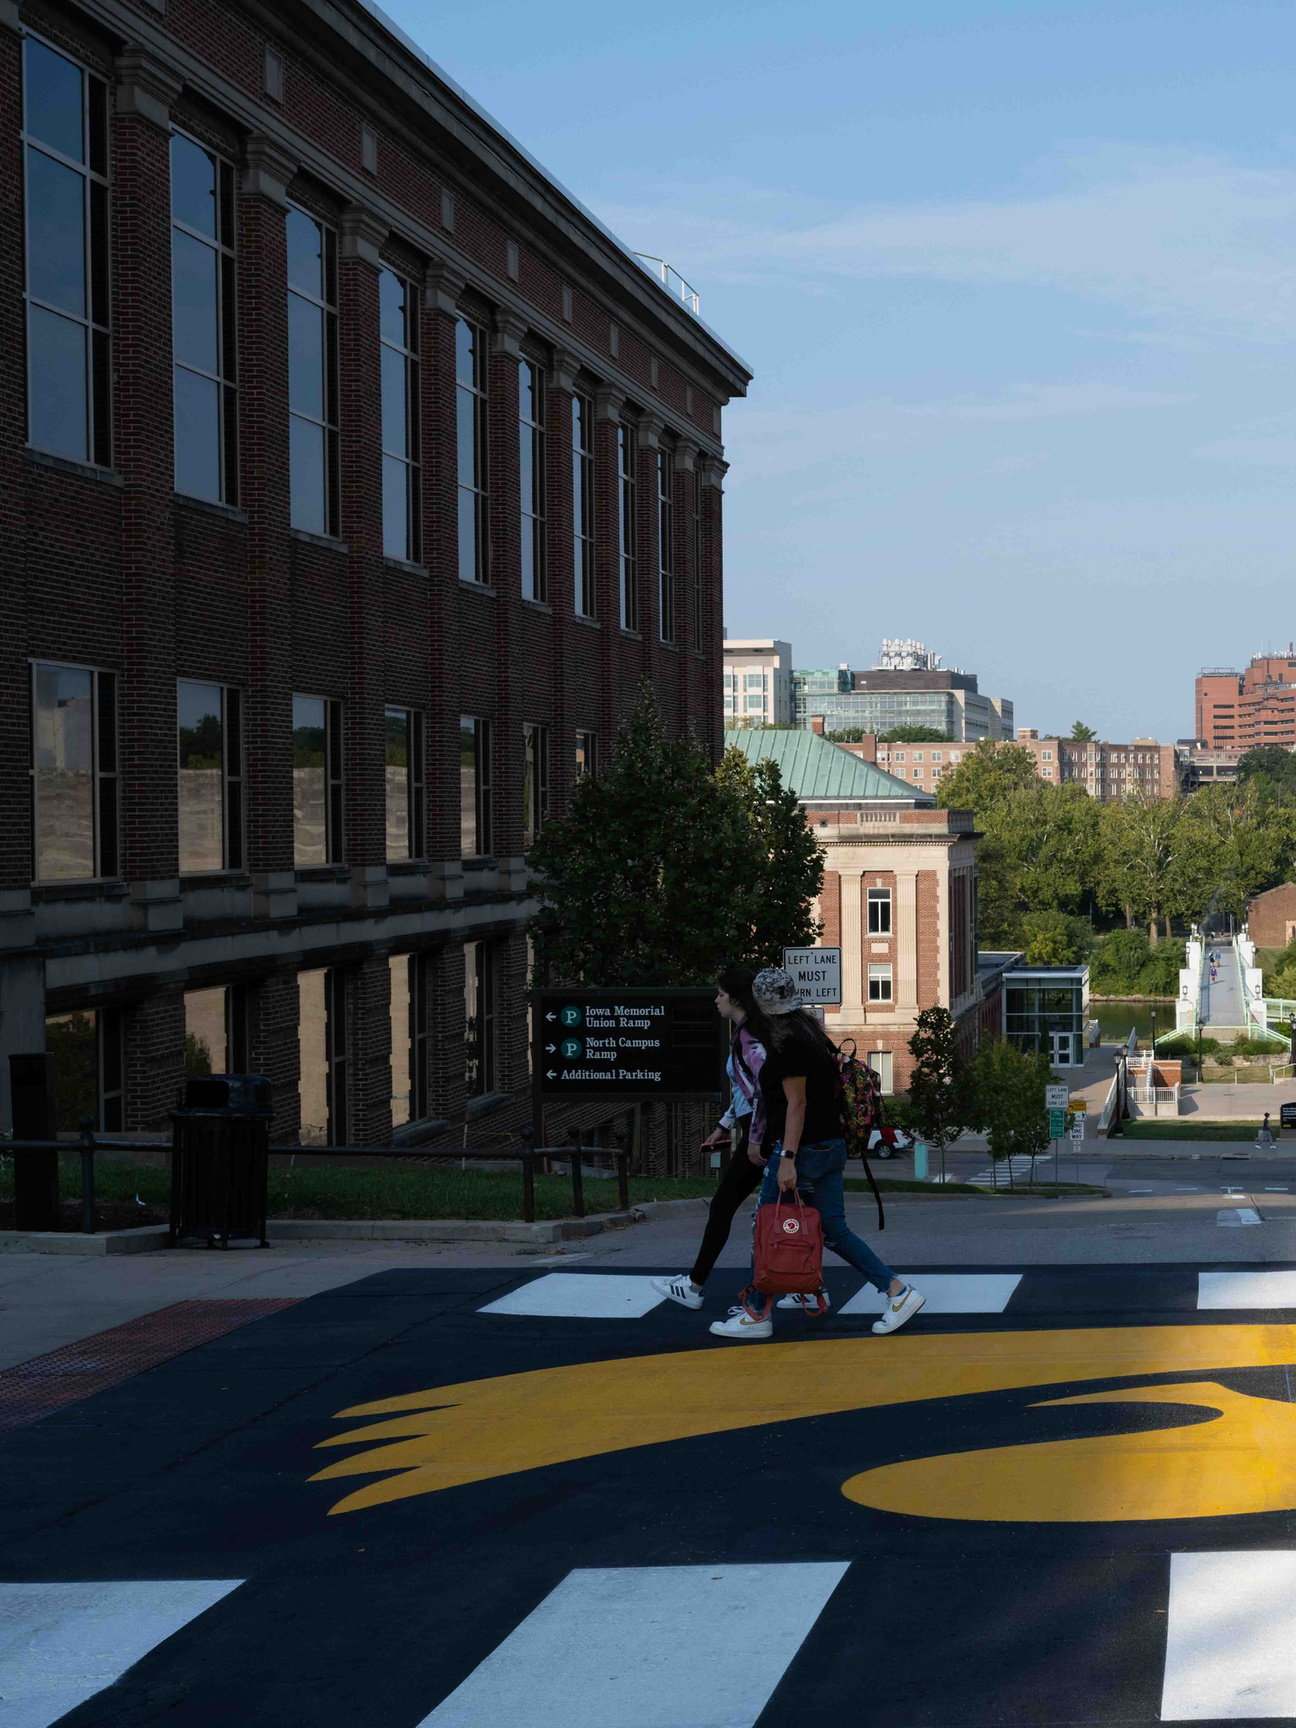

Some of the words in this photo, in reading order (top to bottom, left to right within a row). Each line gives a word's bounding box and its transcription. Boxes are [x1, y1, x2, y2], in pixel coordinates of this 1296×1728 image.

[788, 955, 810, 965] LEFT
[815, 955, 837, 964] LANE
[798, 971, 827, 981] MUST
[795, 988, 811, 997] URN
[816, 988, 837, 997] LEFT
[566, 1010, 577, 1023] P
[585, 1006, 611, 1016] Iowa
[614, 1006, 665, 1016] Memorial
[585, 1017, 616, 1027] Union
[619, 1017, 651, 1029] Ramp
[586, 1037, 616, 1047] North
[618, 1037, 660, 1049] Campus
[566, 1043, 577, 1056] P
[586, 1049, 617, 1061] Ramp
[561, 1069, 616, 1079] Additional
[618, 1069, 661, 1081] Parking
